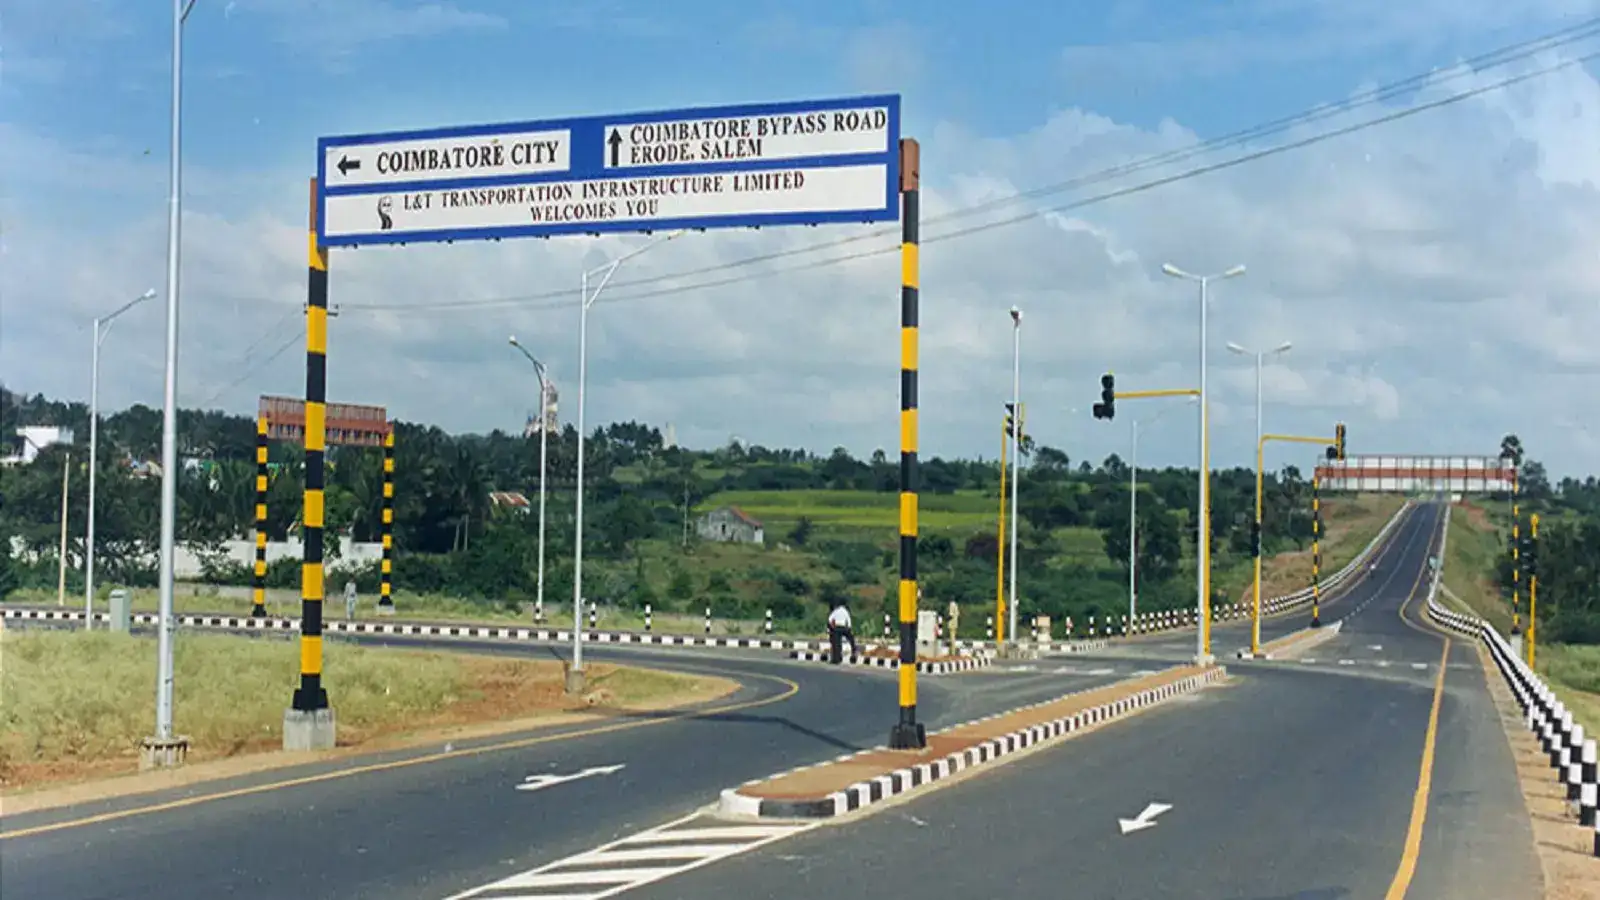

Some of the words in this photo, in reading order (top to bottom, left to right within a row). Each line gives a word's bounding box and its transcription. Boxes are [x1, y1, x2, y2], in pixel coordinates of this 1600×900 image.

[630, 119, 750, 144] COIMBATORE
[757, 113, 827, 138] BYPASS
[833, 110, 886, 132] ROAD
[377, 144, 504, 174] COIMBATORE
[511, 140, 559, 165] CITY
[700, 139, 763, 160] SALEM
[403, 193, 433, 211] L&T
[441, 184, 573, 208] TRANSPORTATION
[583, 175, 723, 199] INFRASTRUCTURE
[733, 171, 805, 192] LIMITED
[530, 201, 616, 222] WELCOMES
[626, 200, 659, 217] YOU
